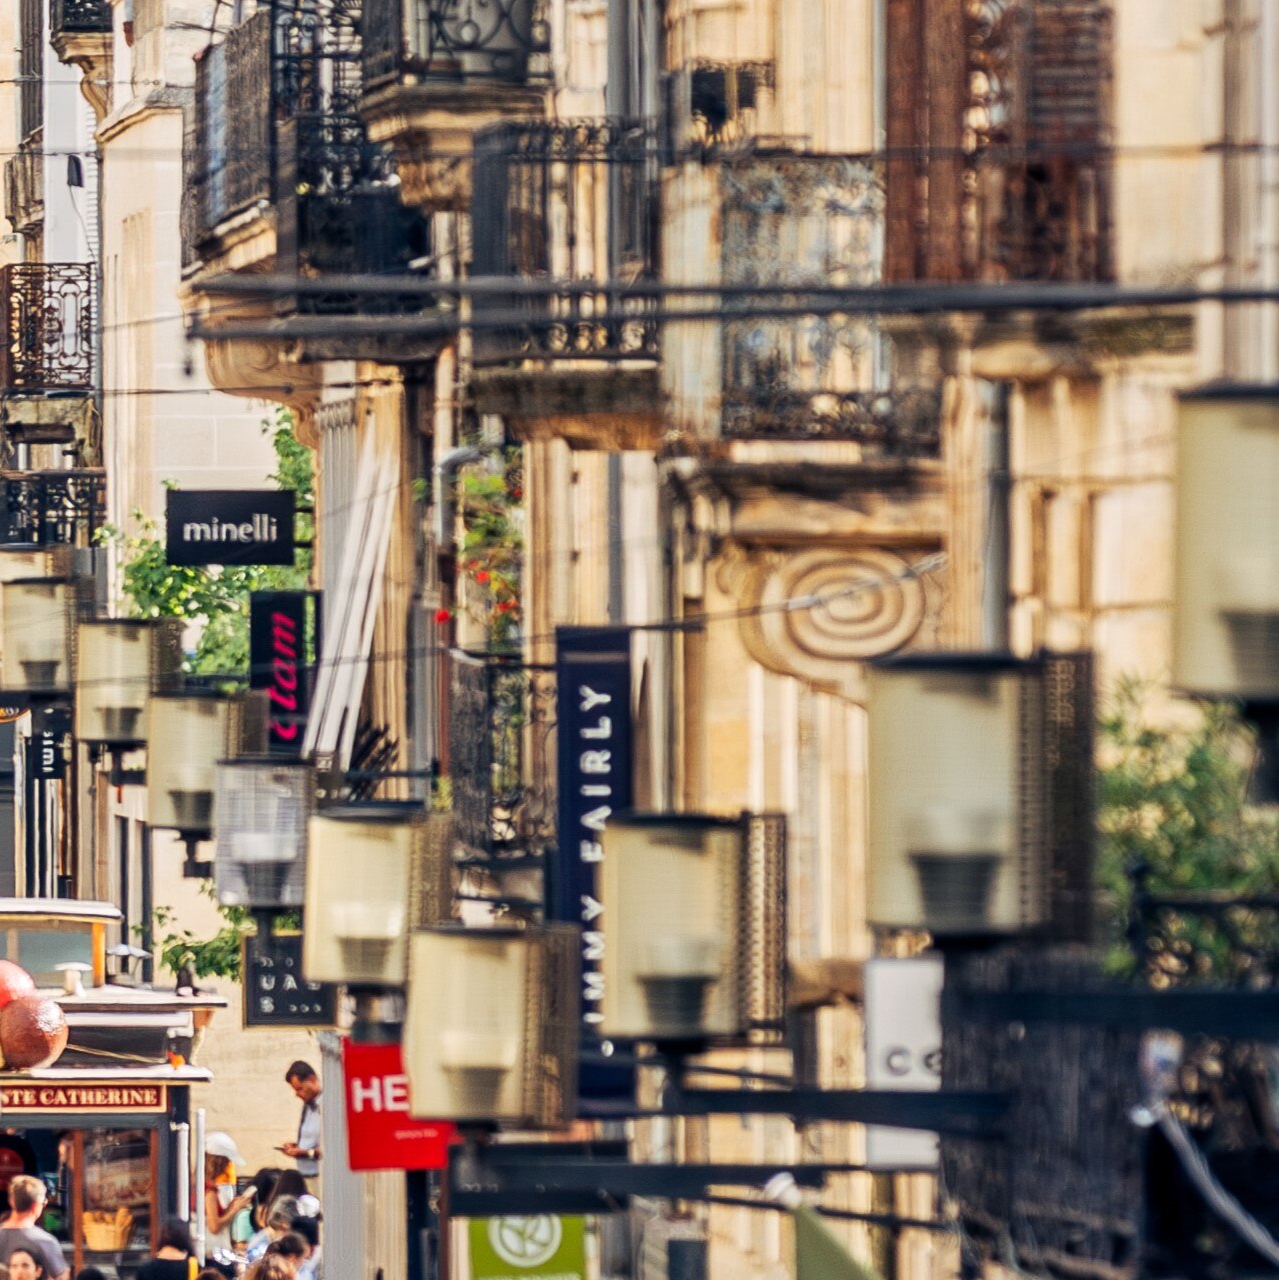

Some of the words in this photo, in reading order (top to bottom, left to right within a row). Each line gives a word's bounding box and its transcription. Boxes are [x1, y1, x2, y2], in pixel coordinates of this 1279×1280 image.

[182, 513, 278, 543] minelli
[579, 685, 612, 863] FAIRLY
[581, 894, 615, 1058] IMMY
[40, 1089, 158, 1107] CATHERINE
